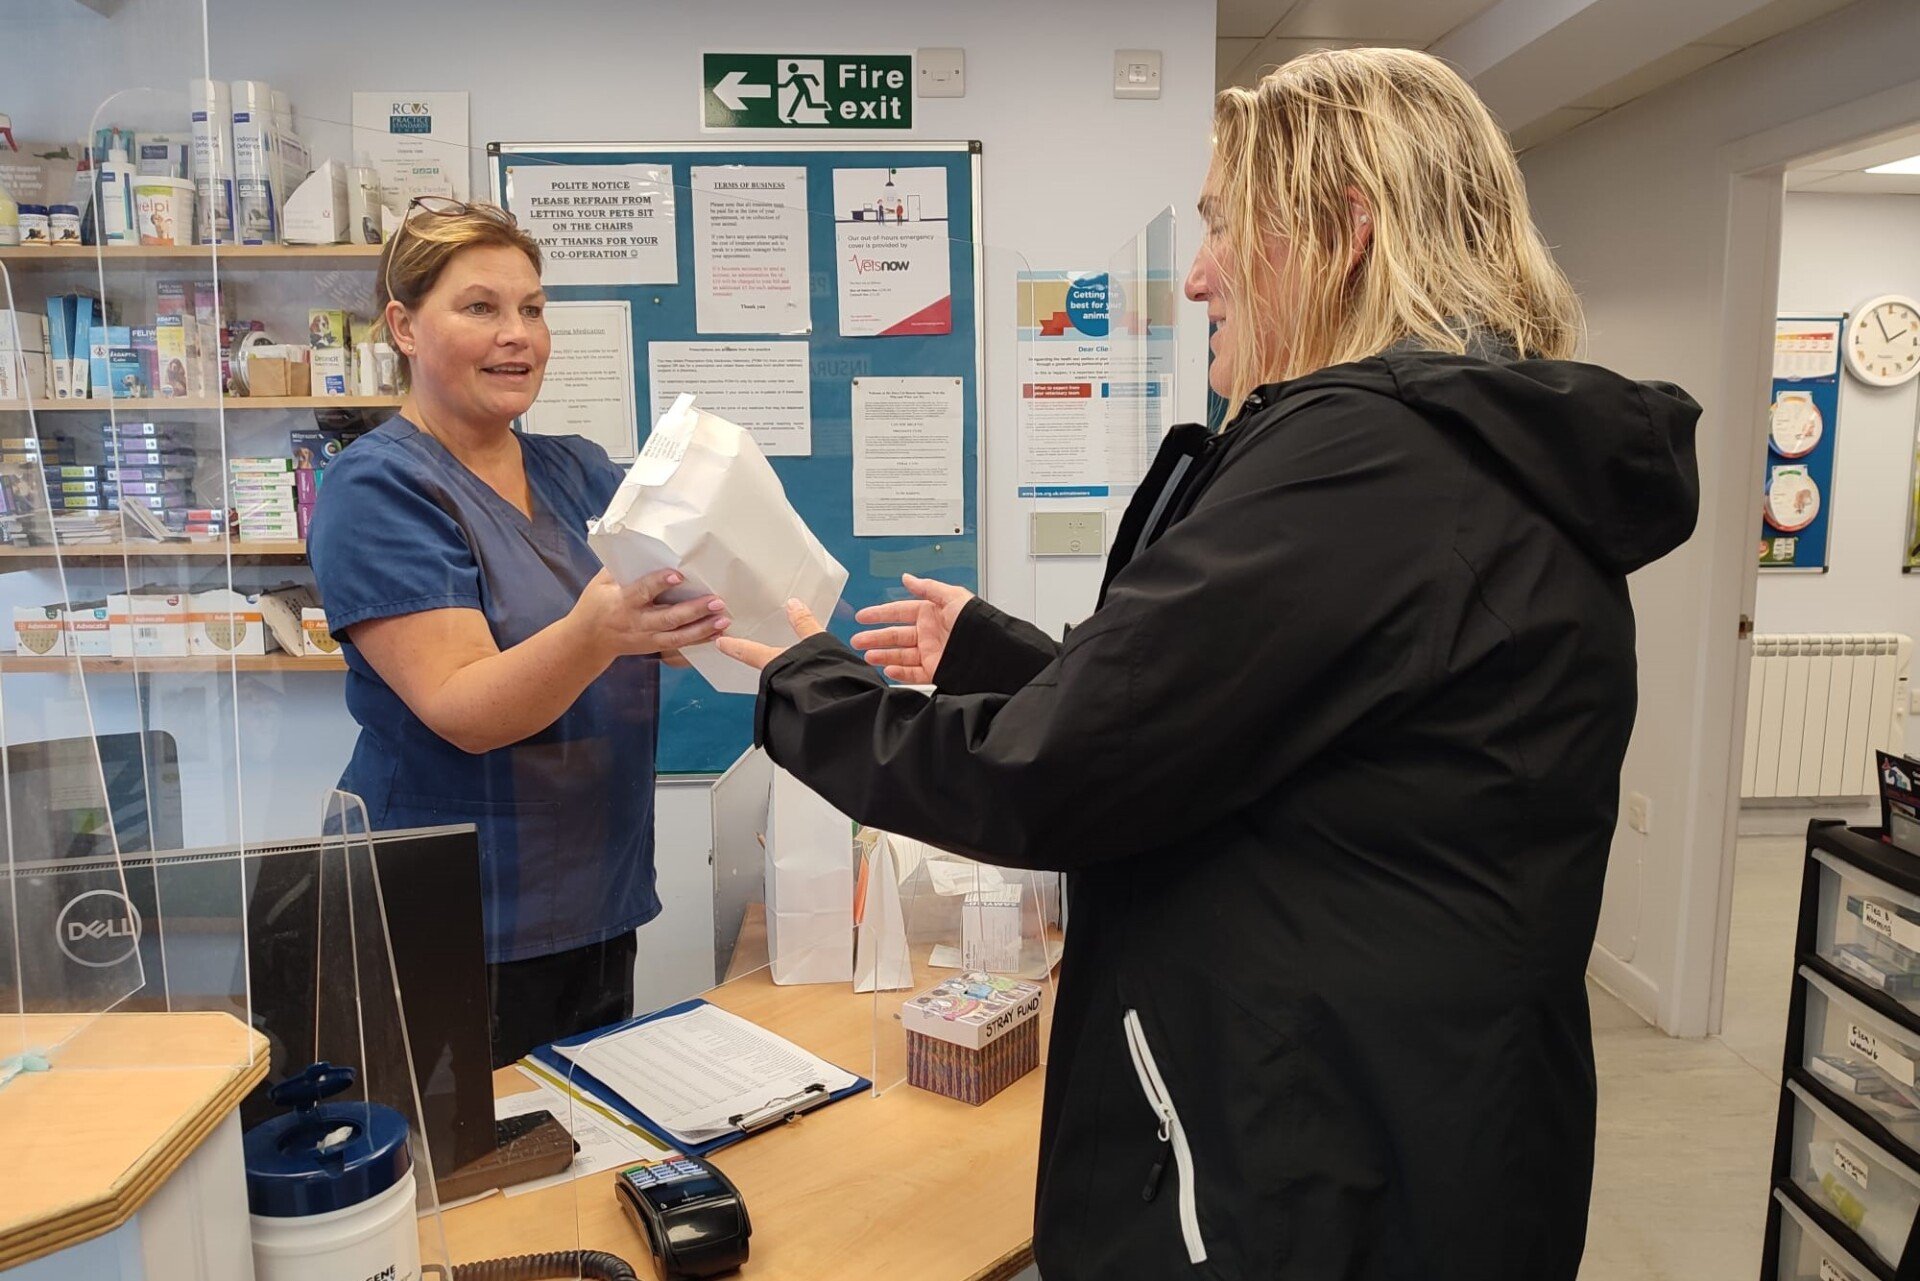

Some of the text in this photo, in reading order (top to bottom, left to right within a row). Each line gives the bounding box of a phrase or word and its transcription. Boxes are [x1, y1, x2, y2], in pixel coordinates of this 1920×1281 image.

[839, 64, 904, 88] Fire
[839, 96, 901, 120] exit
[552, 181, 630, 190] POLITE NOTICE
[531, 196, 651, 205] PLEASE REFRAIN FROM
[530, 209, 654, 218] LETTING YOUR PETS SIT
[552, 222, 633, 231] ON THE CHAIRS
[607, 237, 627, 245] FOR
[550, 250, 628, 258] CO-OPERATION
[1073, 291, 1105, 300] Getting
[1070, 301, 1089, 309] best
[1091, 301, 1104, 309] for
[68, 918, 134, 941] DELL
[986, 997, 1039, 1038] STRAY FUND
